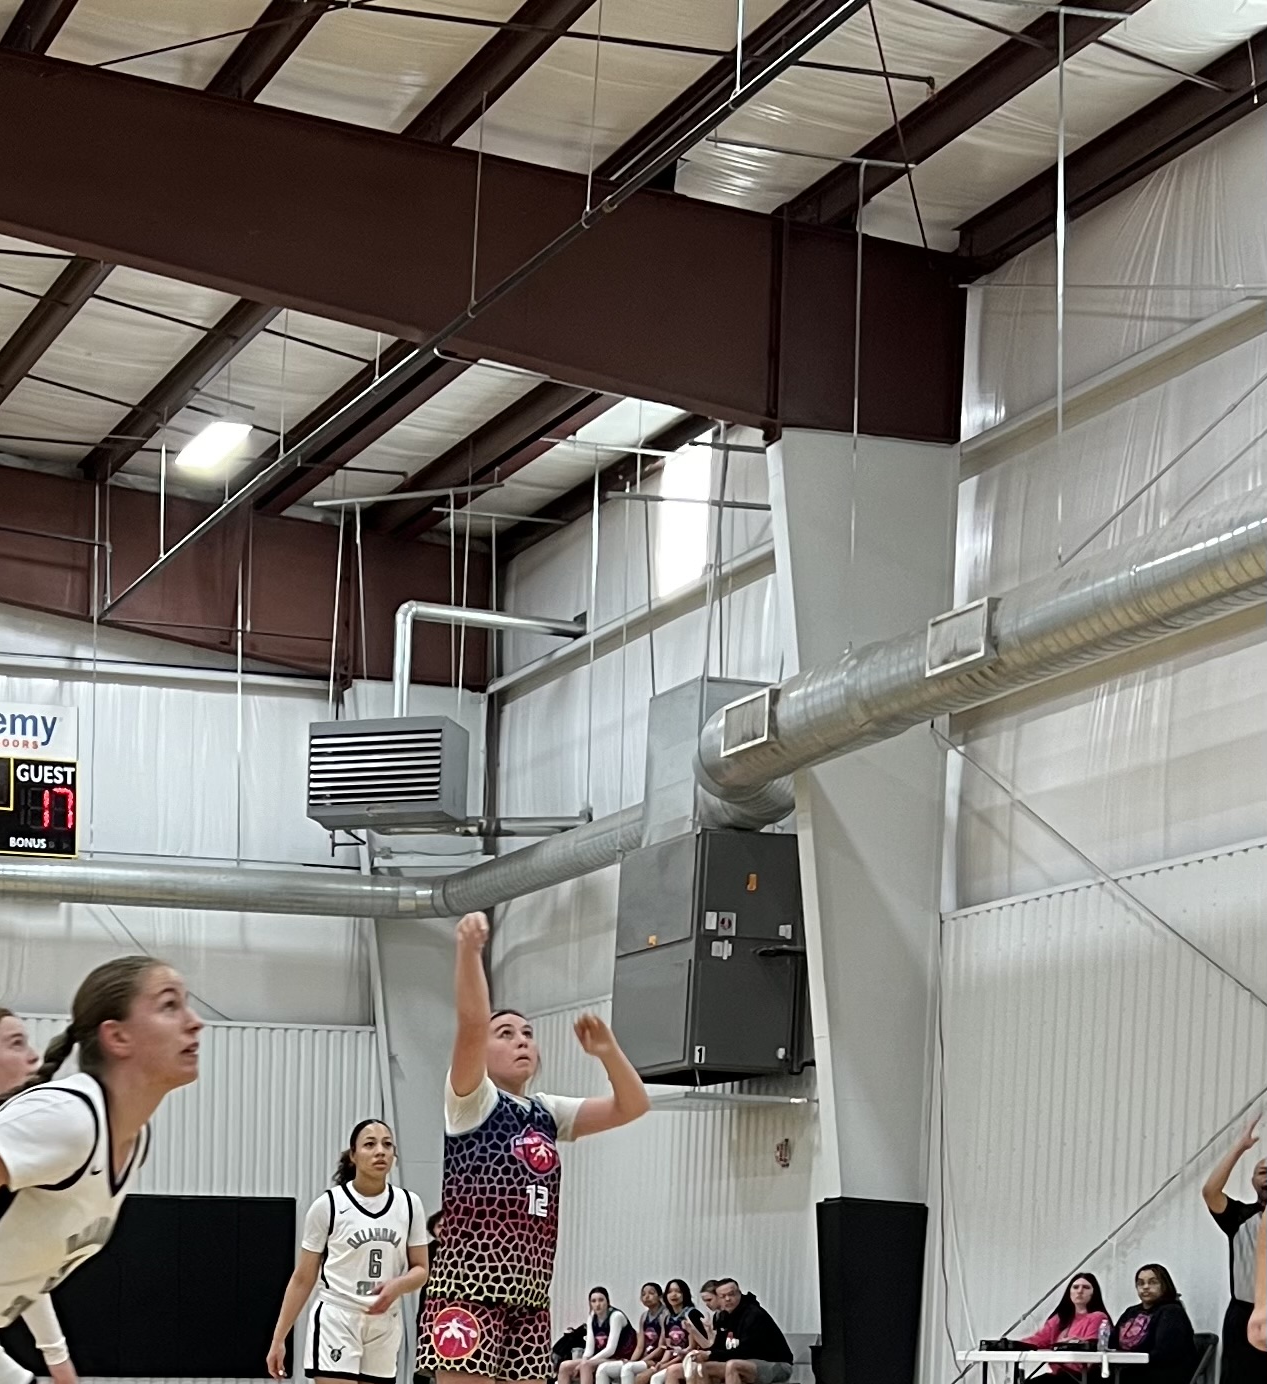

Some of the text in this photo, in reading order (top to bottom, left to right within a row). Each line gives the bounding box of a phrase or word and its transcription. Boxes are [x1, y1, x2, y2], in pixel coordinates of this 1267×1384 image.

[16, 763, 75, 785] GUEST
[9, 837, 47, 849] BONUS
[526, 1185, 548, 1217] 12
[347, 1228, 401, 1249] OKLAHOMA
[369, 1249, 382, 1278] 6
